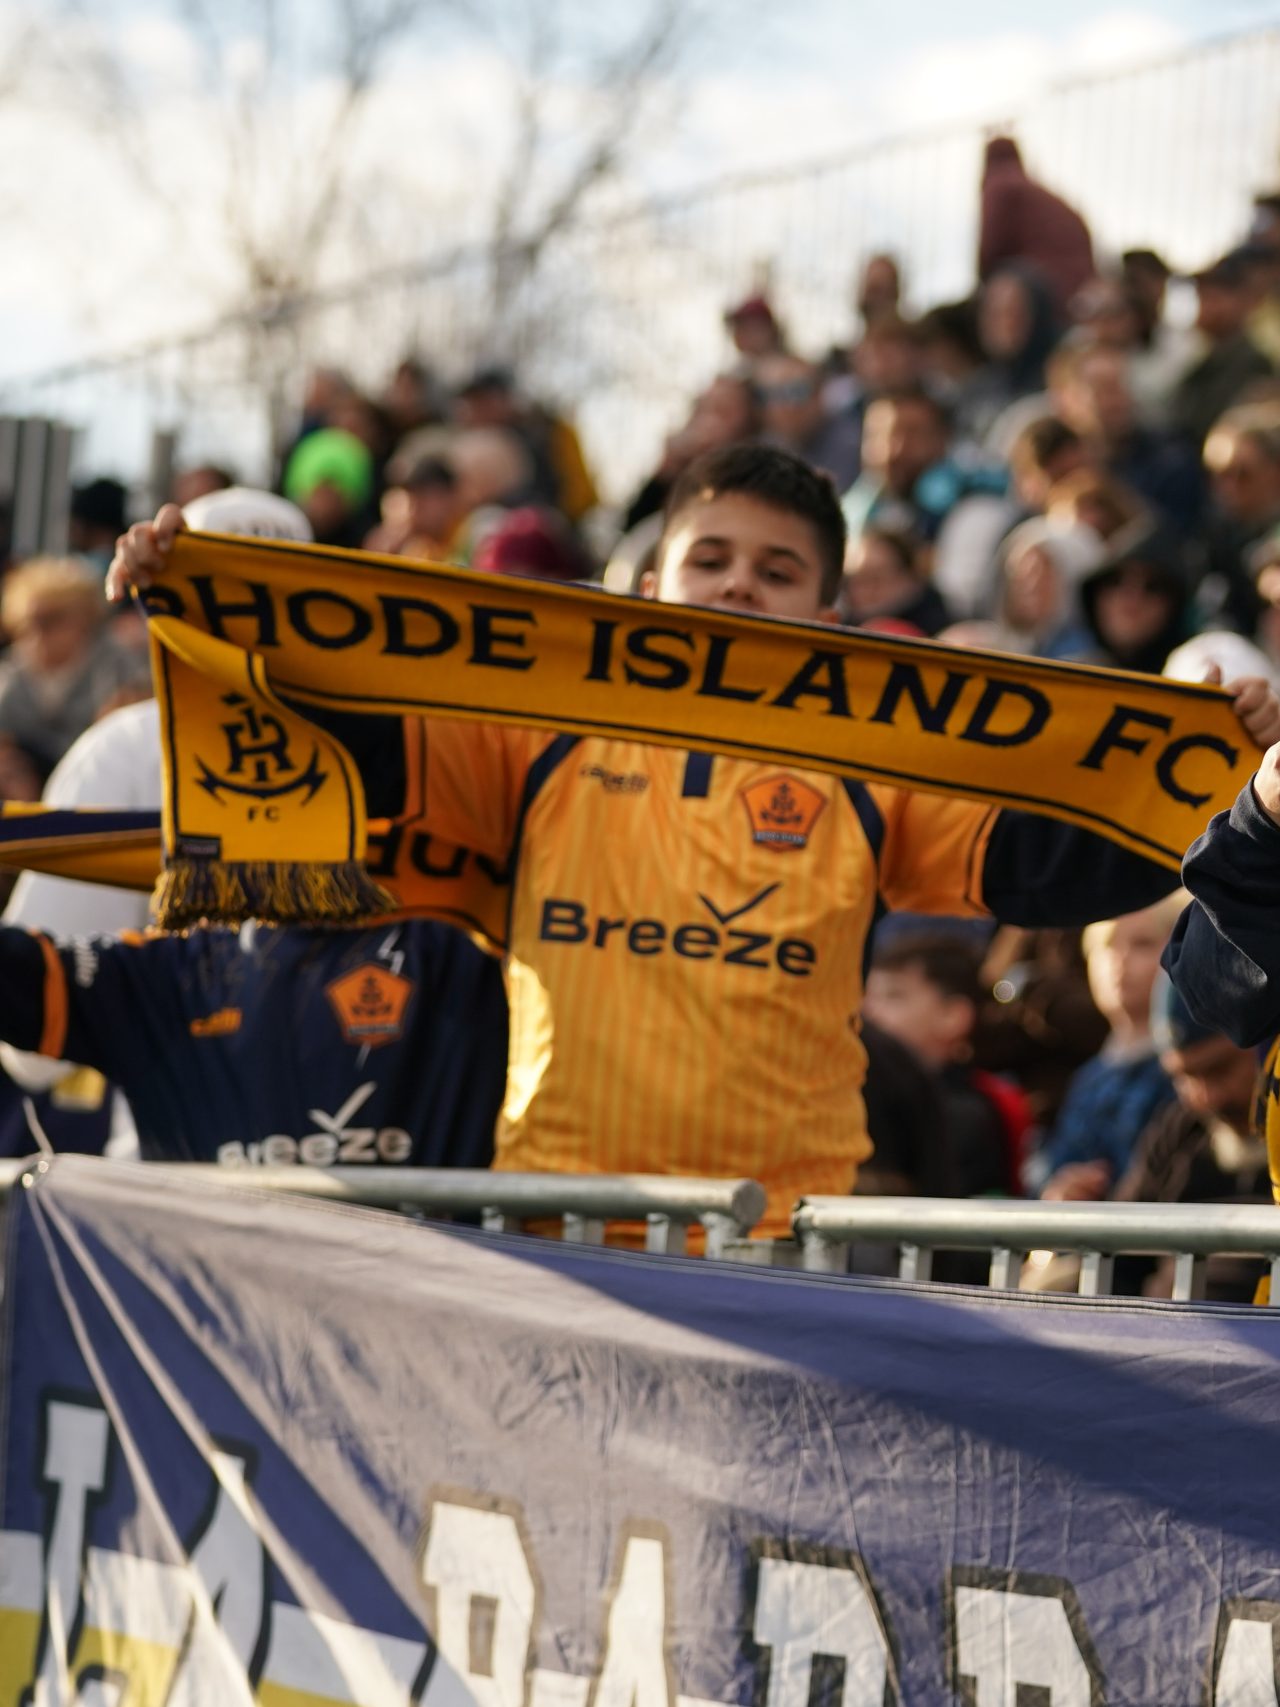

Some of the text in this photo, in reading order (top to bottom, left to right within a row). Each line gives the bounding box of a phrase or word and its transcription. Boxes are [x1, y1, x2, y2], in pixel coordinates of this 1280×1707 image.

[585, 619, 1052, 747] ISLAND
[1077, 704, 1240, 808] FC
[539, 898, 817, 977] Breeze
